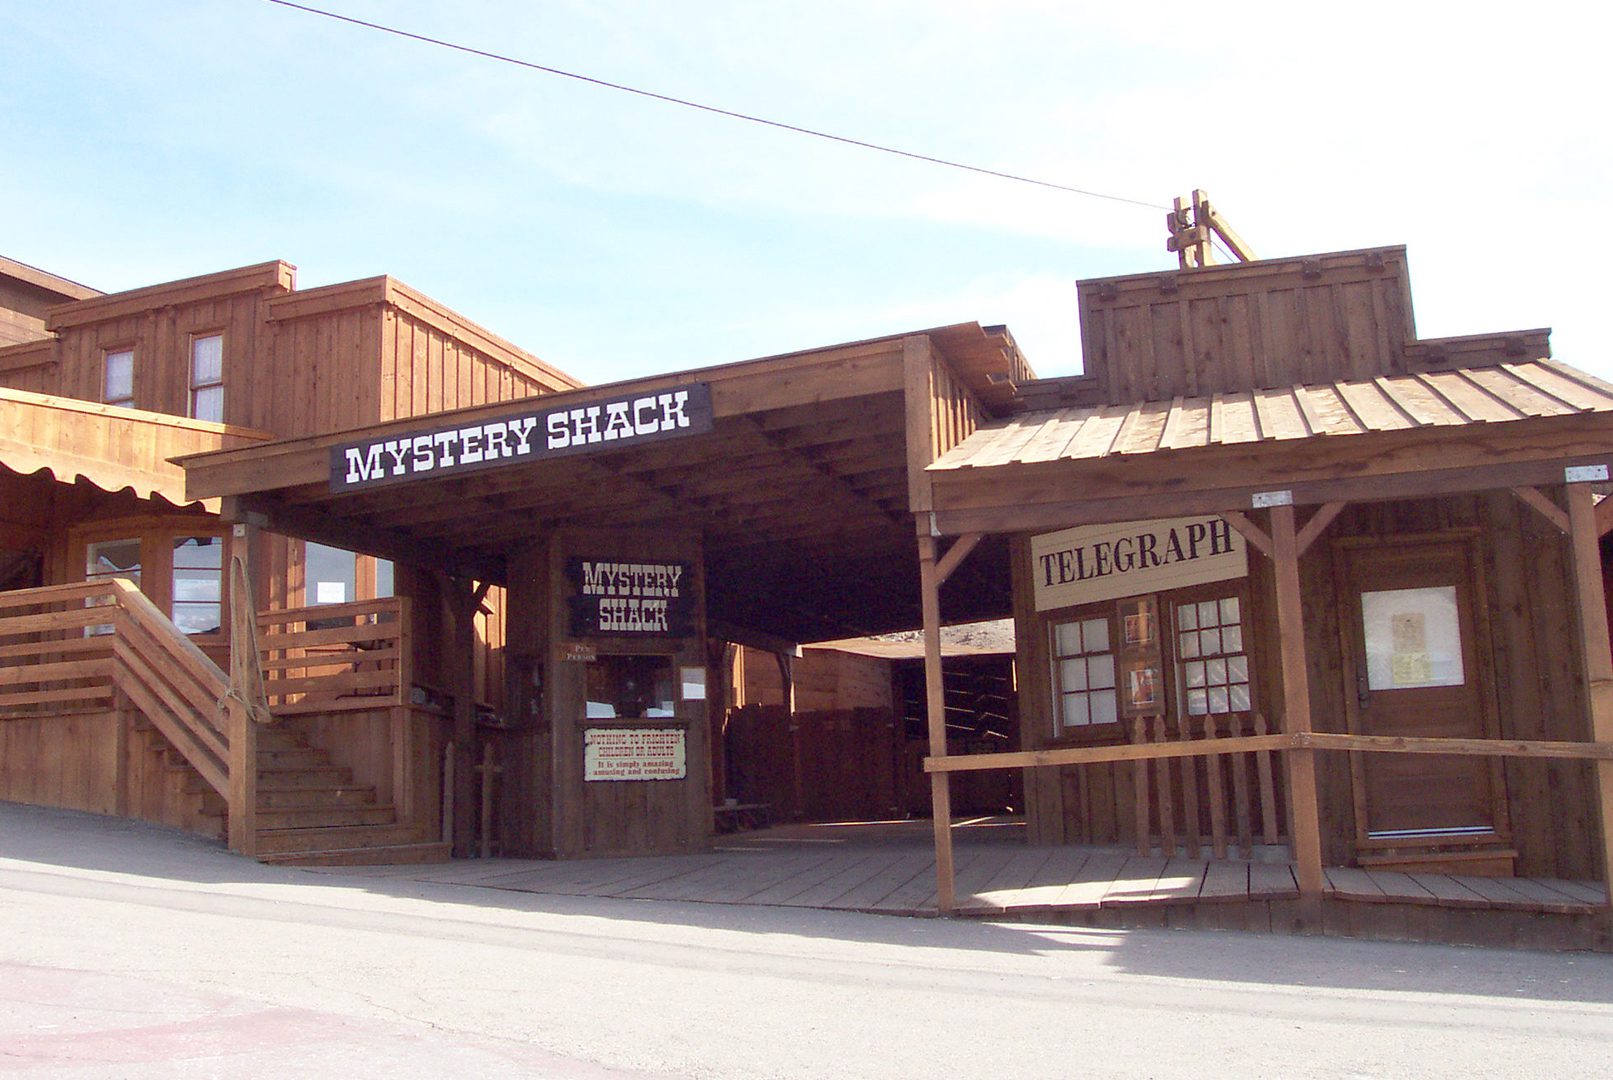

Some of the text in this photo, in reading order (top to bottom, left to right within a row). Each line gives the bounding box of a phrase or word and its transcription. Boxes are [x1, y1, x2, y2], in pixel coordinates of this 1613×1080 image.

[345, 390, 690, 484] MYSTERY SHACK
[1039, 518, 1235, 587] TELEGRAPH
[582, 562, 682, 597] MYSTERY
[599, 598, 668, 631] SHACK
[629, 733, 639, 745] TO
[616, 761, 640, 770] simply
[643, 760, 673, 768] amazing
